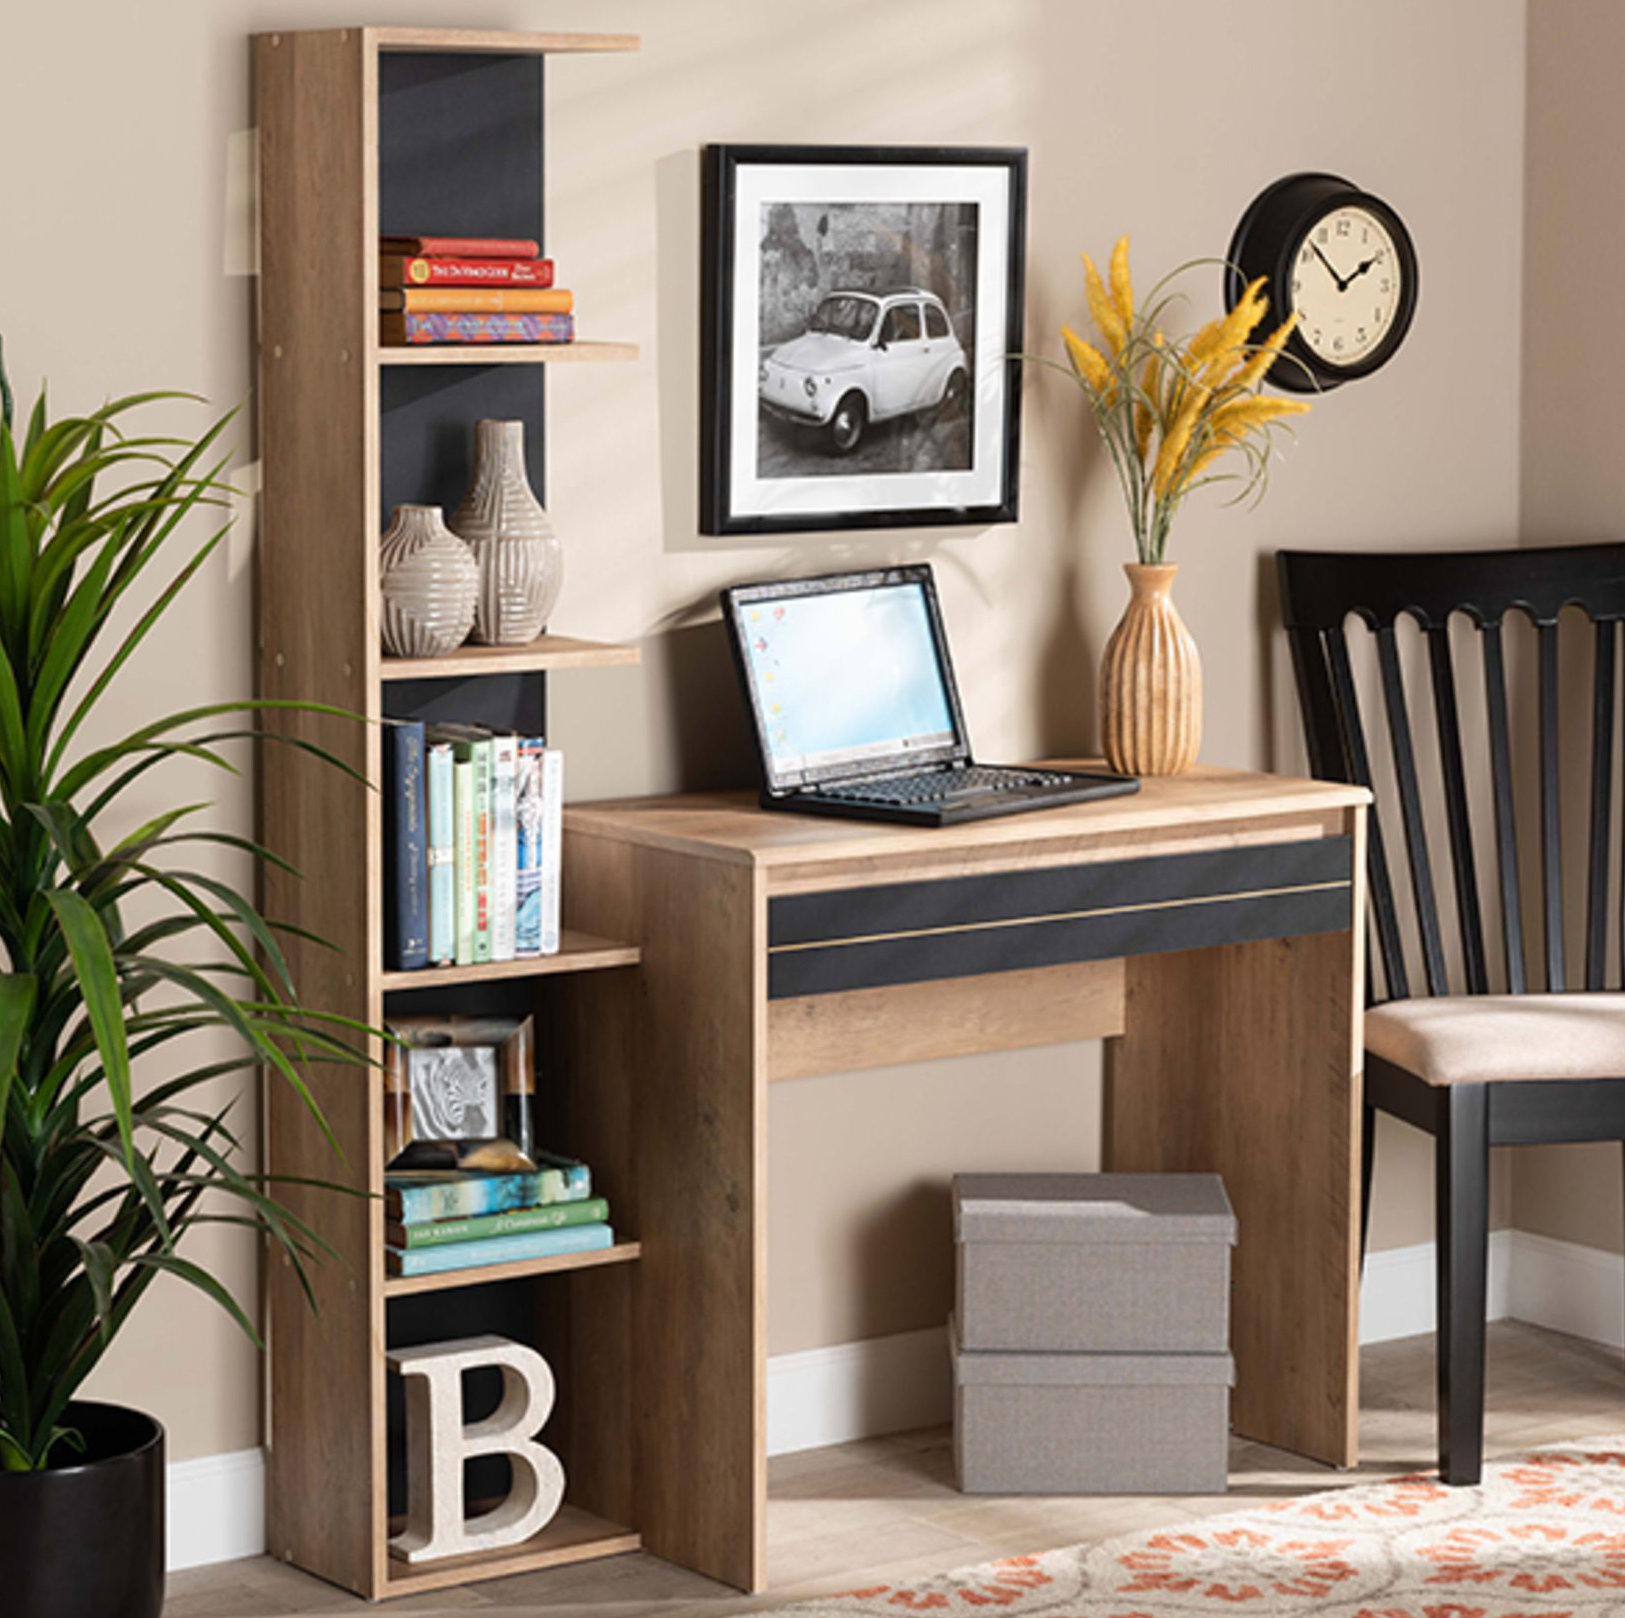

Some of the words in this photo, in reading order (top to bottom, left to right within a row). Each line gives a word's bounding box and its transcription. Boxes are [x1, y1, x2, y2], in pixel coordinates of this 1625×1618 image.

[1336, 220, 1351, 236] 12
[1362, 228, 1368, 244] 1
[1375, 250, 1385, 265] 2
[1380, 278, 1390, 293] 3
[1313, 328, 1322, 345] 7
[1355, 327, 1367, 342] 5
[1333, 336, 1344, 350] 6
[390, 1336, 566, 1563] B
